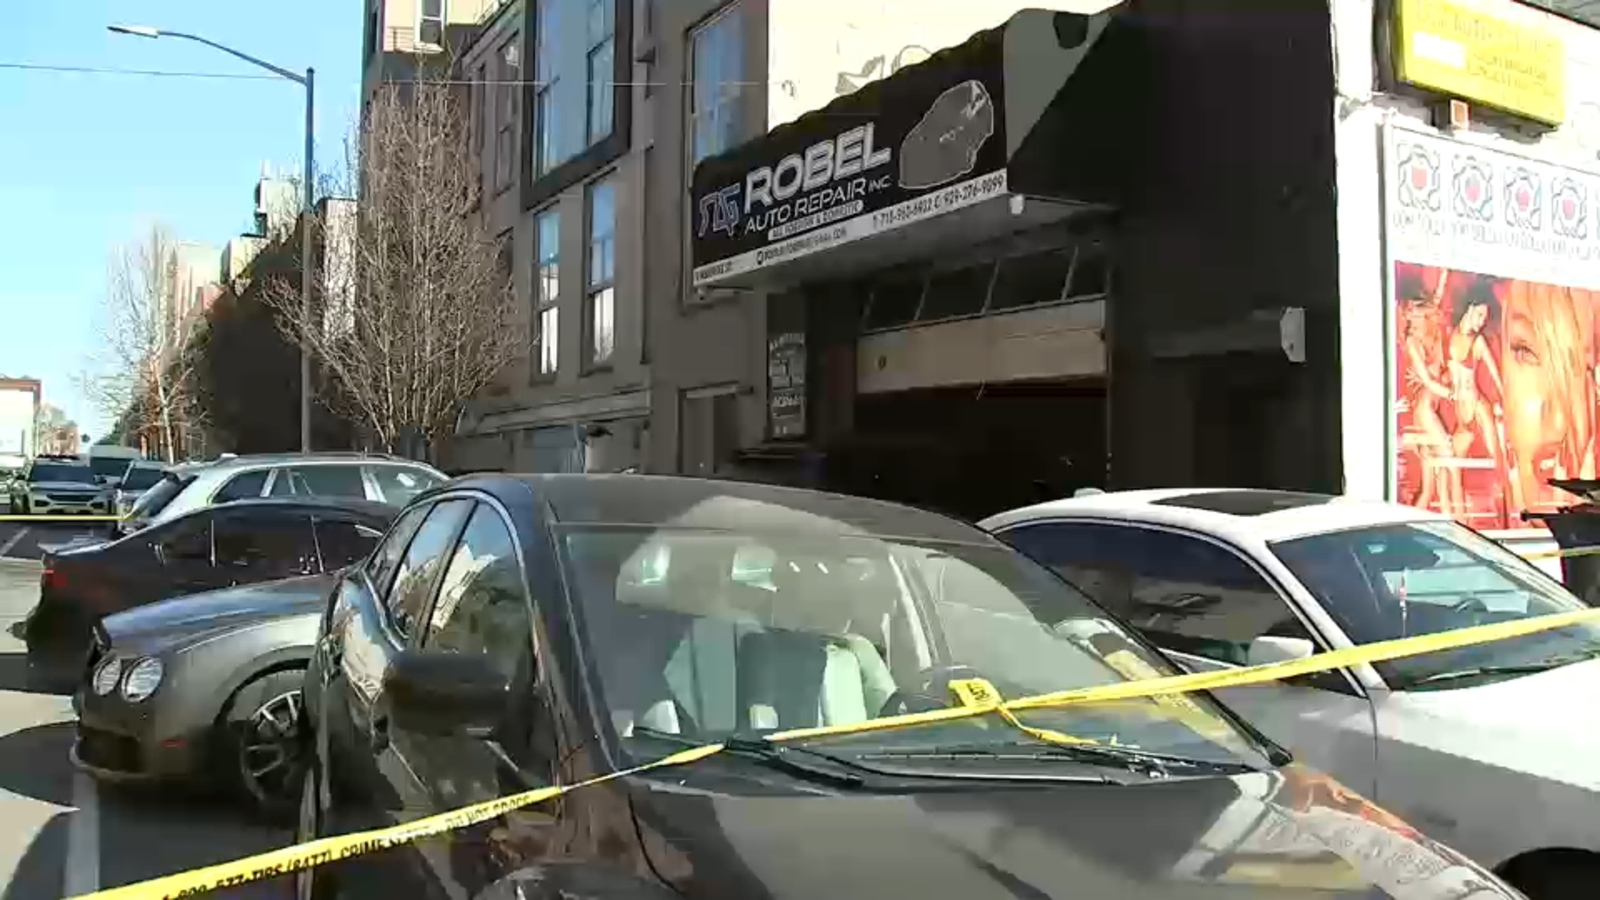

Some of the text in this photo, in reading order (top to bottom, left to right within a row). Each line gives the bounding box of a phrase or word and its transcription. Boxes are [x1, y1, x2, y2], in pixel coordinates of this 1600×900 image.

[744, 121, 892, 214] ROBEL
[745, 204, 791, 235] AUTO
[794, 177, 867, 218] REPAIR
[868, 174, 892, 193] INC
